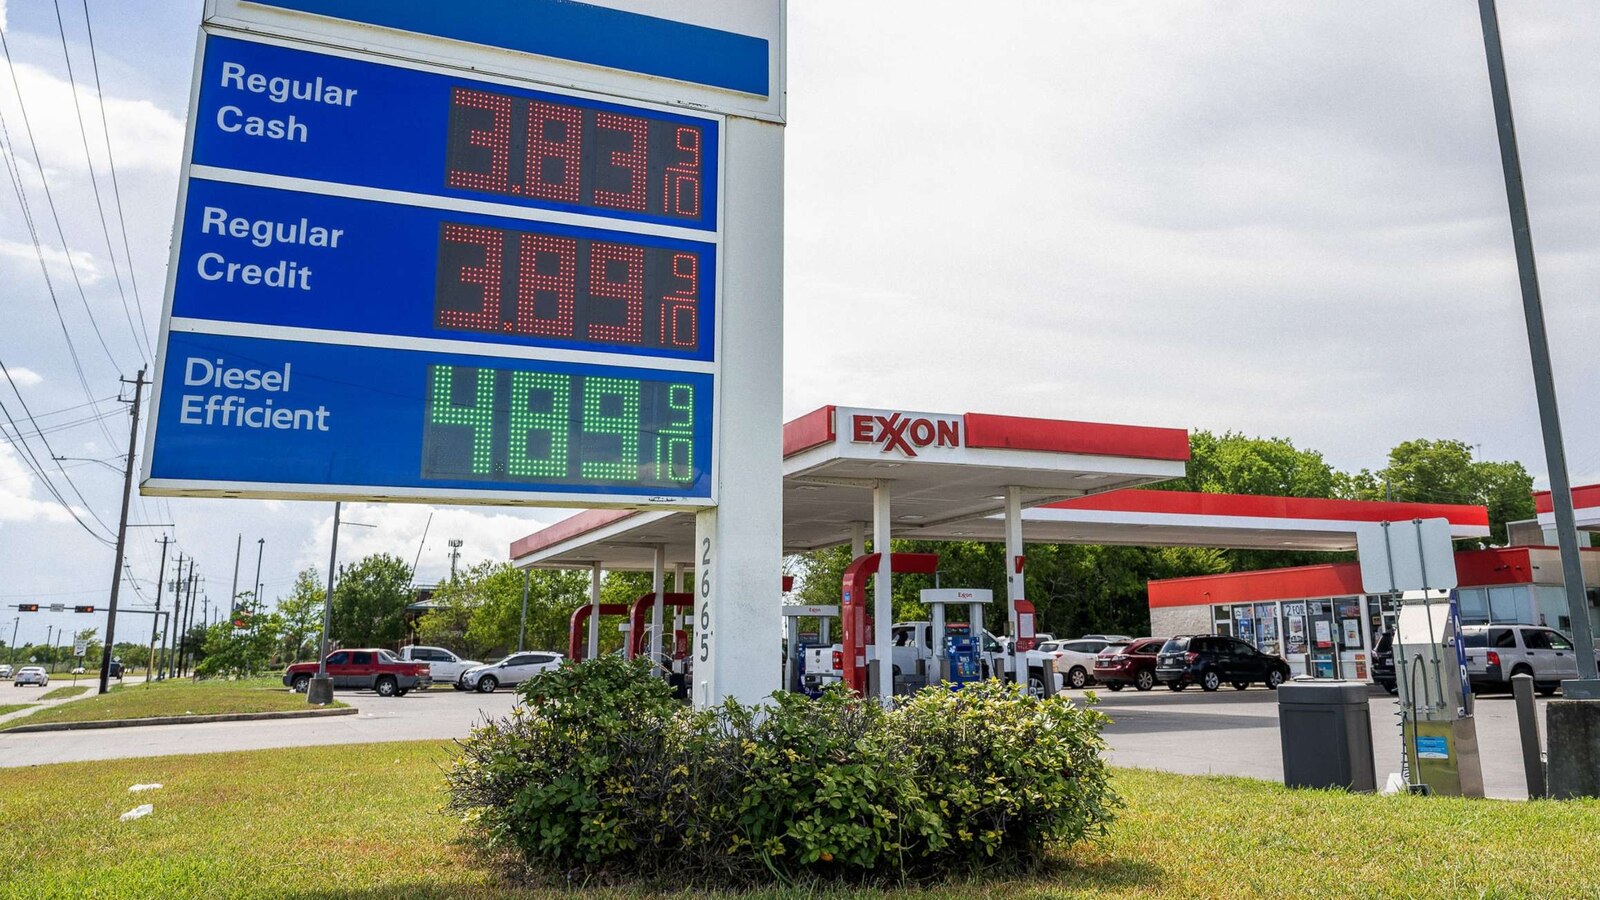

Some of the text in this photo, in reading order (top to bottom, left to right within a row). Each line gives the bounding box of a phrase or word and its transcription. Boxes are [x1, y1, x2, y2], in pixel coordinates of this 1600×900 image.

[221, 61, 358, 107] Regular
[216, 106, 308, 143] Cash
[450, 88, 648, 209] 3.83
[202, 206, 344, 249] Regular
[197, 252, 312, 291] Credit
[440, 224, 644, 343] 3.89
[184, 357, 292, 394] Diesel
[180, 395, 330, 432] Efficient
[853, 412, 959, 456] EXXON
[699, 536, 711, 663] 2665
[1454, 615, 1468, 687] AIR
